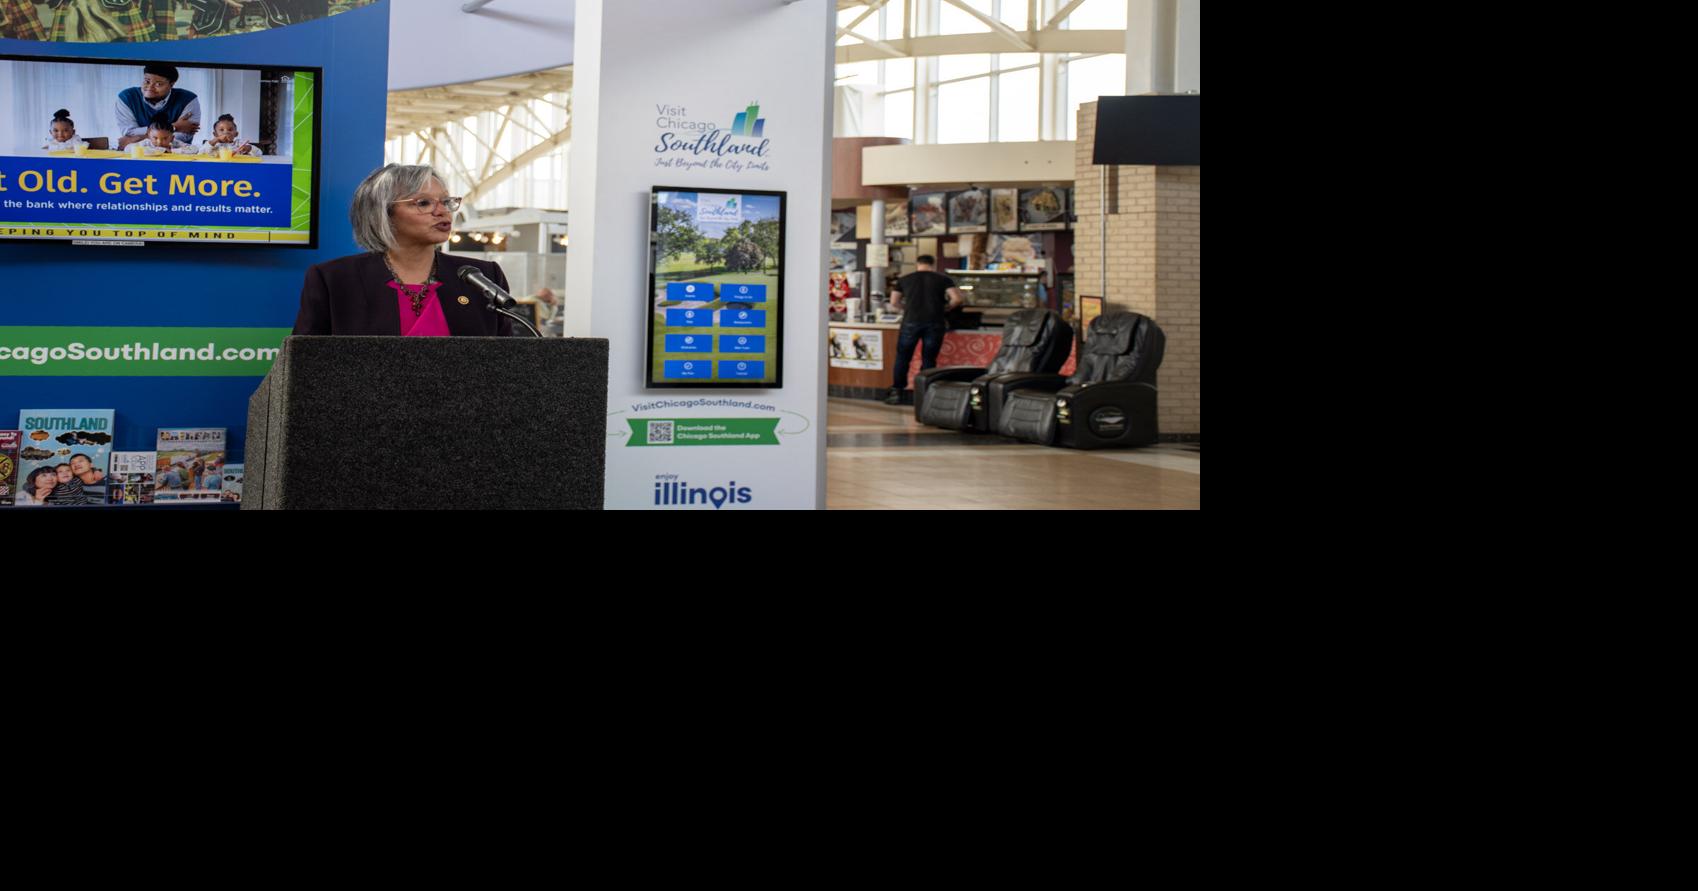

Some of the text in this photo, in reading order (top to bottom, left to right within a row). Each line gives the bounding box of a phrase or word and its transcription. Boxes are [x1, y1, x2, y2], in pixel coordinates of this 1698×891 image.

[656, 103, 686, 116] Visit
[656, 117, 716, 132] Chicago
[654, 129, 769, 157] Southland
[655, 158, 769, 172] Just Beyond the City Limits
[18, 169, 88, 194] Old.
[99, 172, 158, 195] Get
[169, 174, 260, 198] More.
[4, 200, 273, 214] the bank where relationships and results matter.
[189, 231, 235, 239] MIND
[632, 398, 775, 412] VisitChicagoSouthland.com
[25, 416, 108, 430] SOUTHLAND
[655, 473, 679, 481] enjoy
[655, 481, 752, 509] illinois
